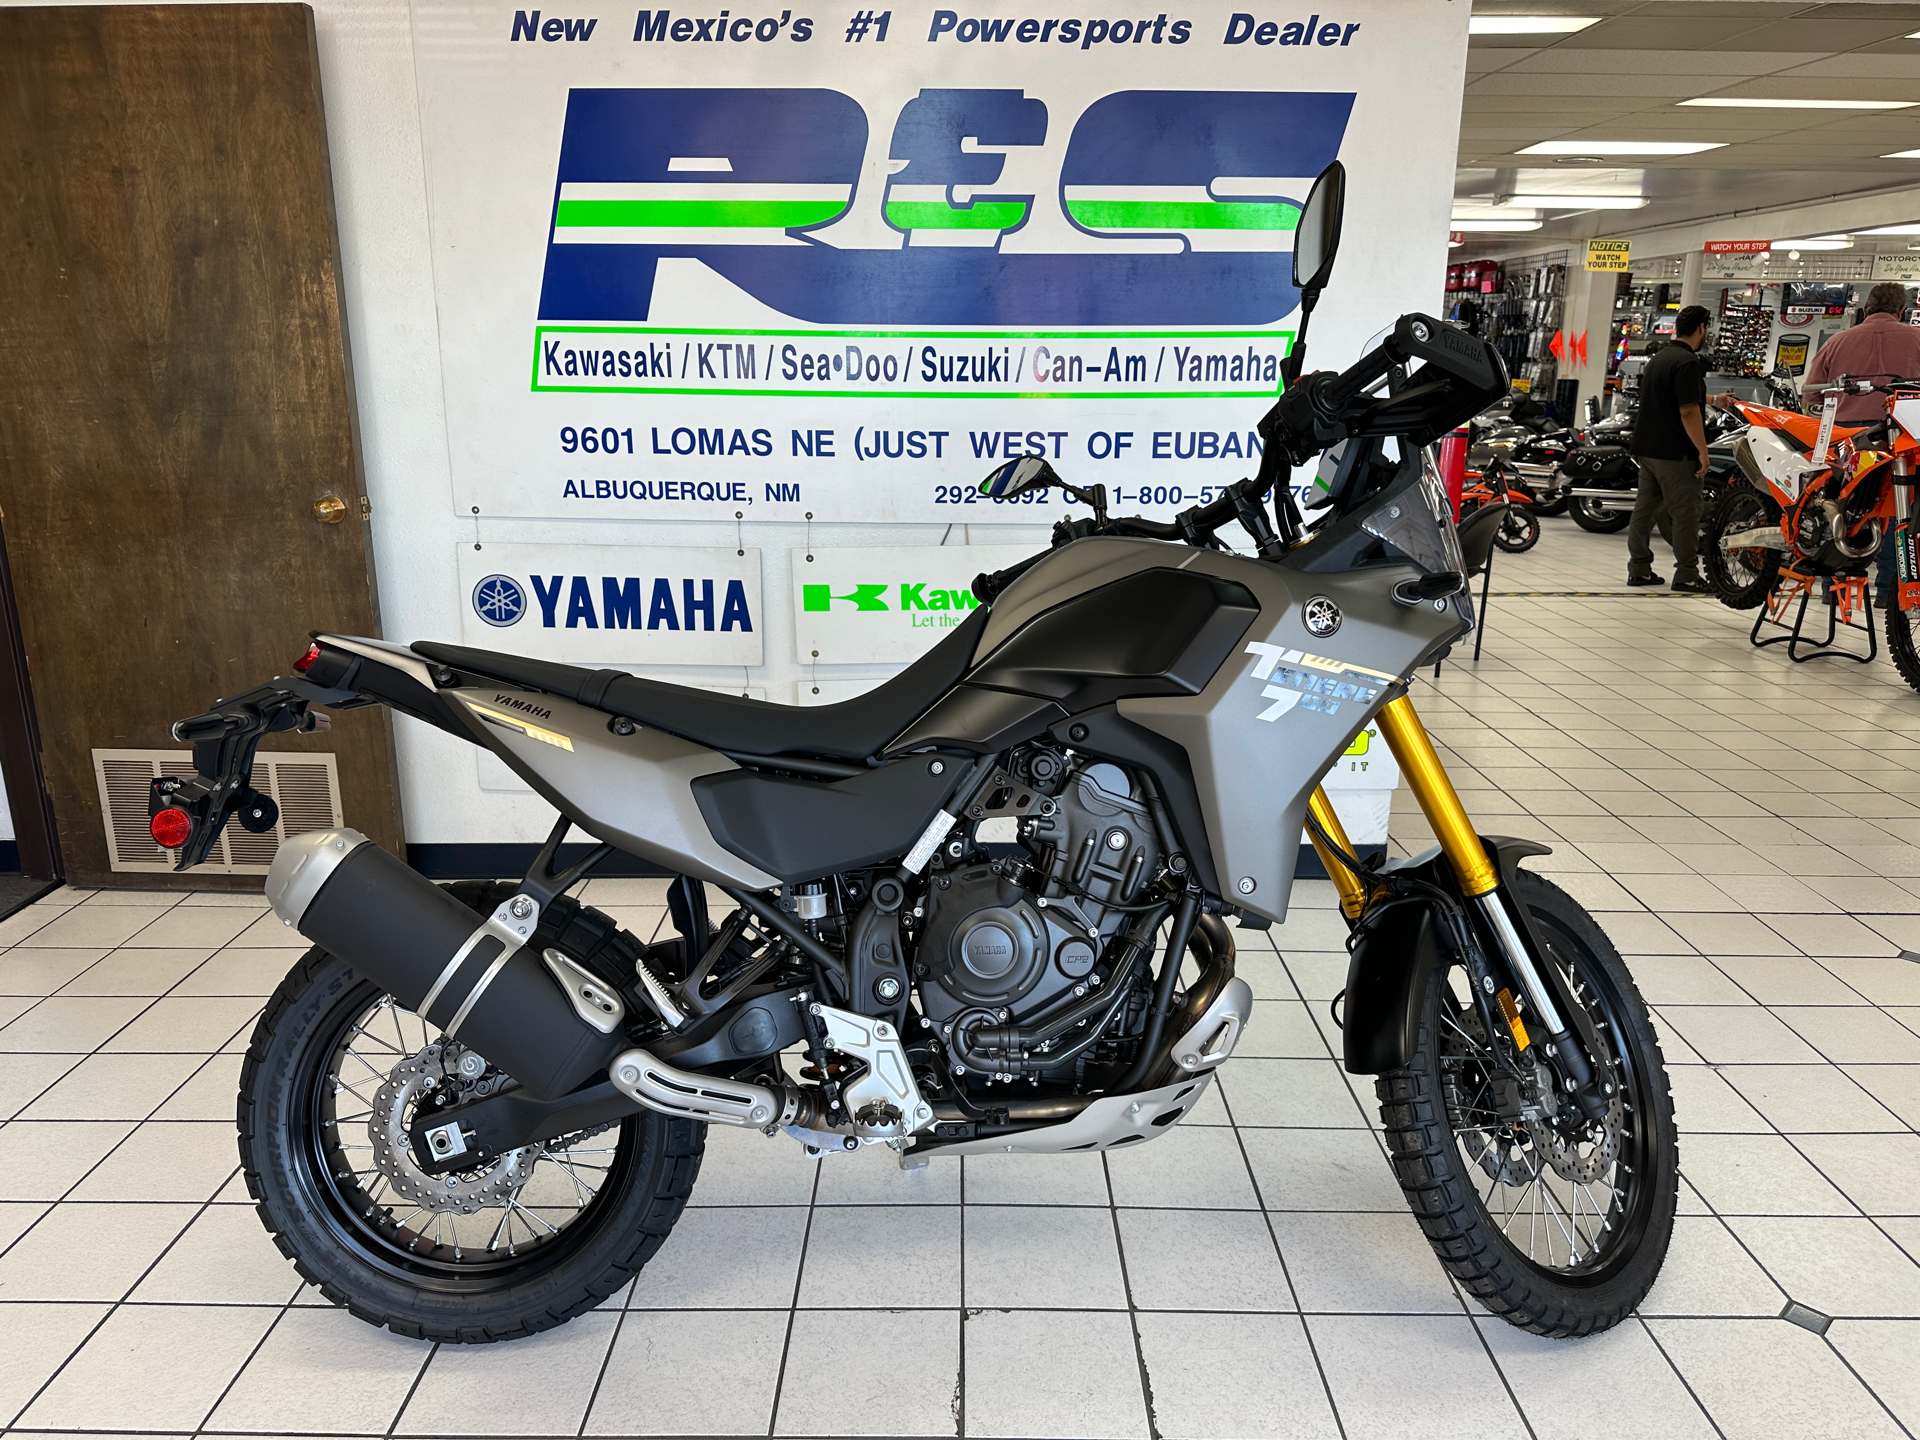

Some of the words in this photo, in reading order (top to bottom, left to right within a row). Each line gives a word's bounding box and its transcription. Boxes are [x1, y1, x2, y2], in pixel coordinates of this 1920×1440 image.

[512, 11, 596, 42] New
[634, 11, 812, 42] Mexico's
[846, 11, 890, 42] #1
[928, 10, 1192, 49] Powersports
[1224, 13, 1360, 46] Dealer
[1590, 242, 1628, 251] NOTICE
[1710, 243, 1732, 251] WATCH
[1751, 242, 1767, 250] STEP
[543, 340, 673, 378] Kawasaki
[697, 343, 756, 379] KTM
[921, 345, 1010, 383] Suzuki
[1032, 346, 1147, 383] Can-Am
[1173, 346, 1277, 382] Yamaha
[1444, 334, 1483, 364] YAMAHA
[560, 426, 634, 454] 9601
[652, 427, 773, 457] LOMAS
[791, 429, 836, 457] NE
[854, 426, 950, 461] (JUST
[969, 431, 1069, 460] WEST
[1087, 431, 1134, 460] OF
[563, 480, 753, 505] ALBUQUERQUE,
[765, 483, 801, 503] NM
[1908, 538, 1918, 579] DUNLOP
[529, 574, 754, 633] YAMAHA
[911, 613, 935, 628] Let
[939, 612, 960, 628] the
[493, 694, 552, 719] YAMAHA
[973, 945, 1007, 955] YAMAHA
[1065, 955, 1089, 963] CP2
[276, 995, 324, 1077] RALLY
[267, 1080, 306, 1223] SCORPION
